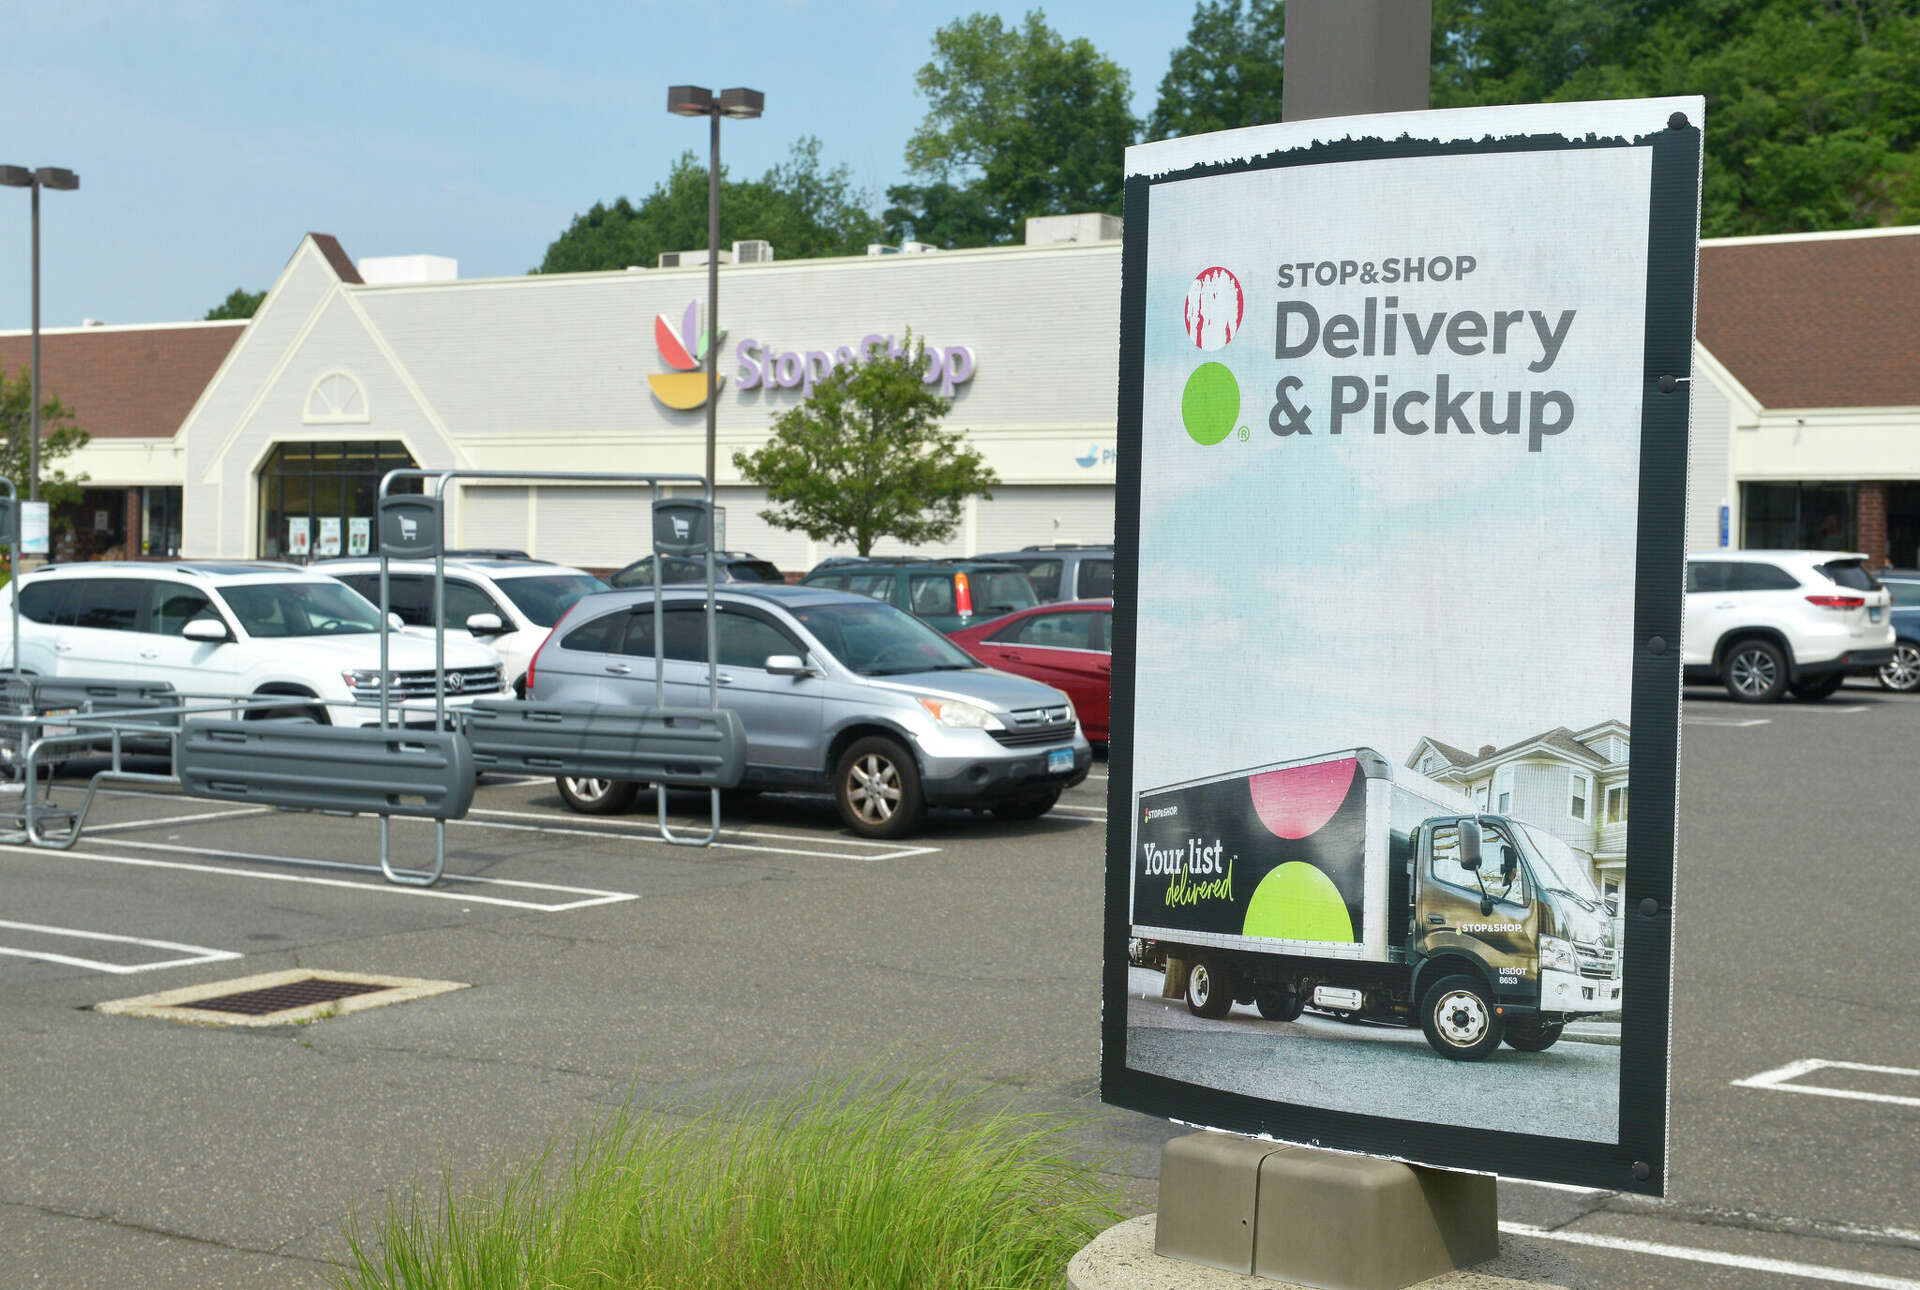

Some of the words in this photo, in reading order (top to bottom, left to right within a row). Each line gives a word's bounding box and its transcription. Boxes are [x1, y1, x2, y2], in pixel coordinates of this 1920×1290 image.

[1277, 255, 1477, 289] STOP&SHOP
[1275, 296, 1577, 373] Delivery
[1268, 375, 1313, 437] &
[1330, 374, 1575, 453] Pickup
[1144, 842, 1184, 875] Your
[1189, 838, 1223, 874] list
[1165, 858, 1234, 908] delivered
[1499, 967, 1527, 976] USDOT
